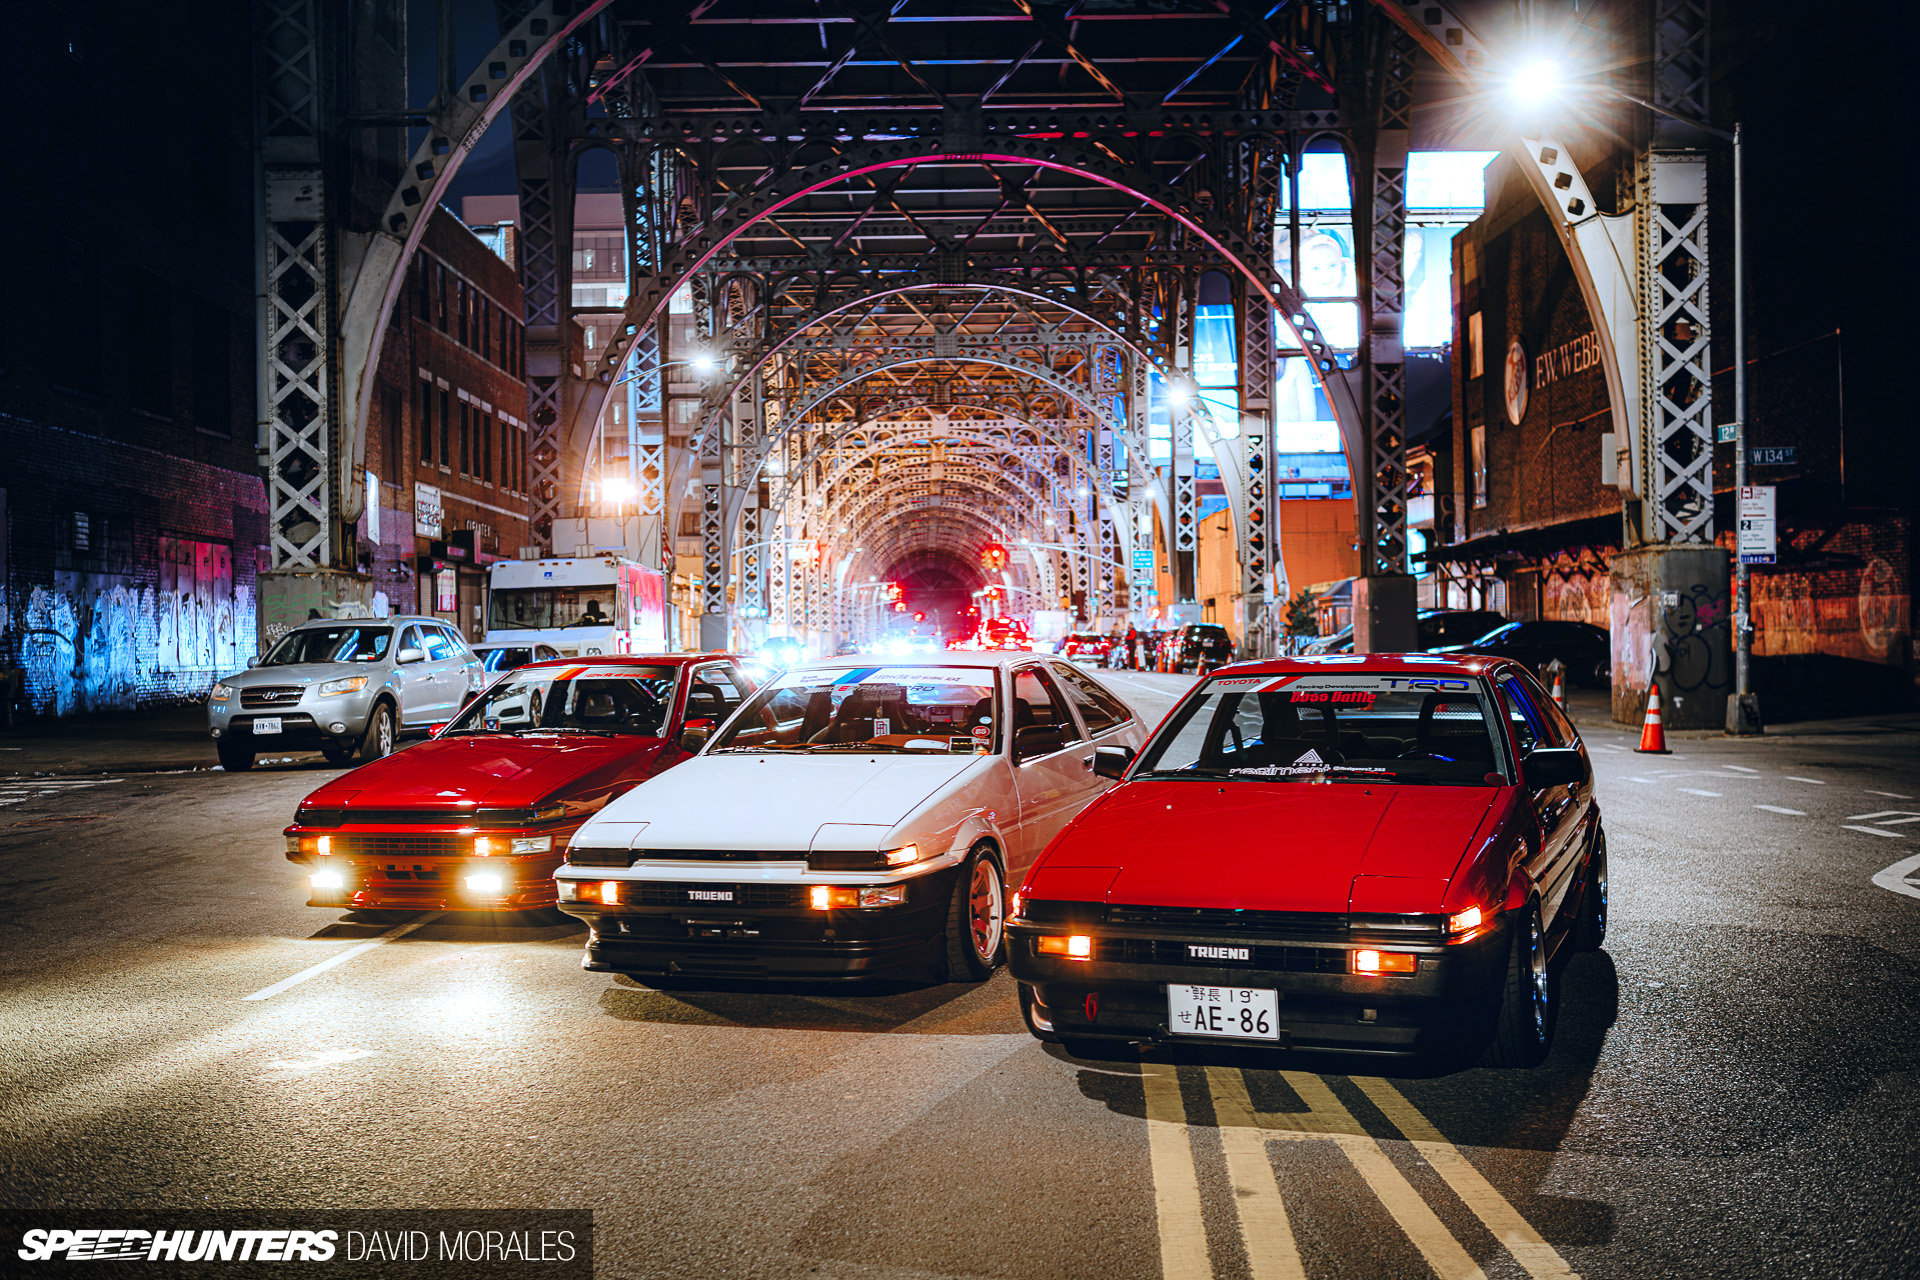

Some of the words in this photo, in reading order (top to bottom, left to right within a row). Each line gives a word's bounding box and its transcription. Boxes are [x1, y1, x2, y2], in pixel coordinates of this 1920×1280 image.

[1536, 348, 1558, 389] F.W.
[1560, 331, 1600, 378] WEBB
[1754, 450, 1762, 462] W
[1765, 449, 1783, 462] 134
[1217, 678, 1261, 686] TOYOTA
[1381, 678, 1470, 692] TRD
[688, 890, 734, 901] TRUENO
[1188, 945, 1250, 961] TRUENO
[1194, 1005, 1270, 1034] AE-86
